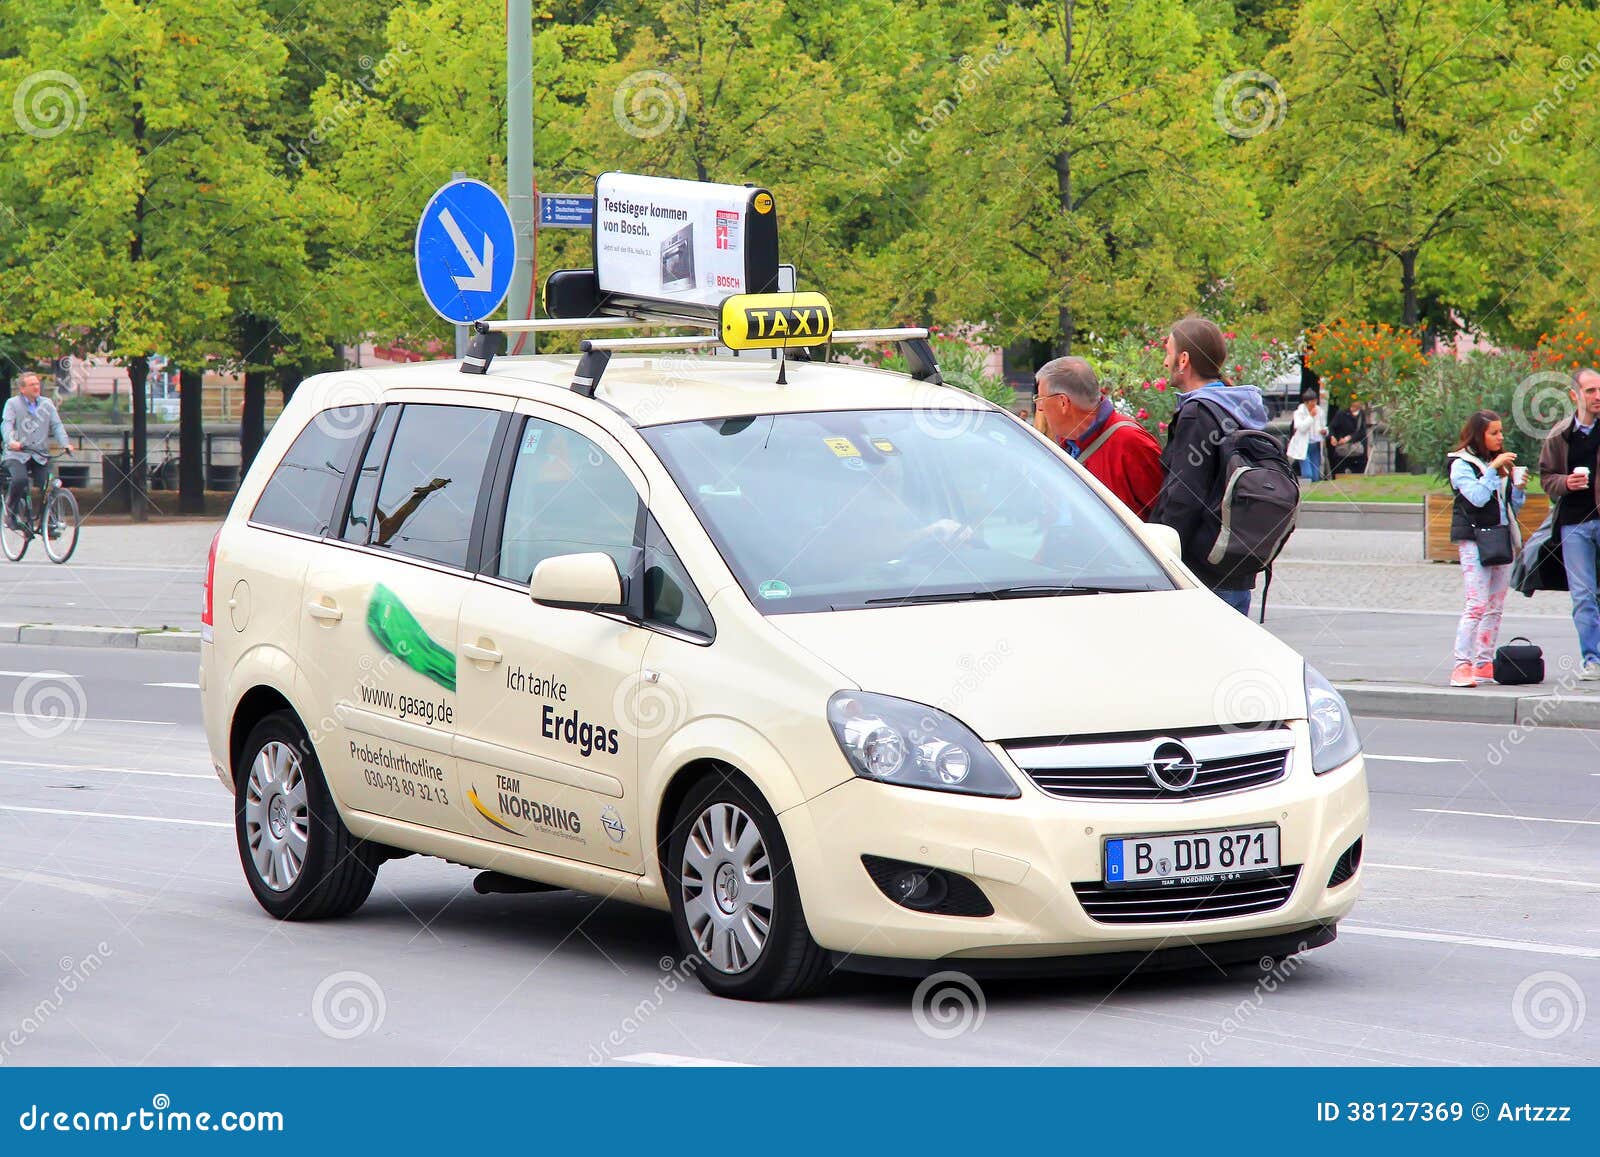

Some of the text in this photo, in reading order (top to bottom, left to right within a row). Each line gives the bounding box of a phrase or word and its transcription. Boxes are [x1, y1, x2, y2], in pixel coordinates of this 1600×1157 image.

[604, 198, 688, 220] Testsieger kommen
[603, 220, 650, 236] von Bosch.
[717, 276, 740, 288] BOSCH
[751, 309, 824, 337] TAXI
[506, 665, 567, 701] Ich tanke
[542, 704, 619, 757] Erdgas
[350, 740, 443, 781] Probefahrthotline
[364, 768, 449, 805] 030-93 89 32 13
[496, 774, 520, 794] TEAM
[498, 792, 581, 834] NORDRING
[1135, 833, 1268, 875] B DD 871
[1111, 864, 1119, 874] D
[1180, 874, 1215, 885] NORDRING
